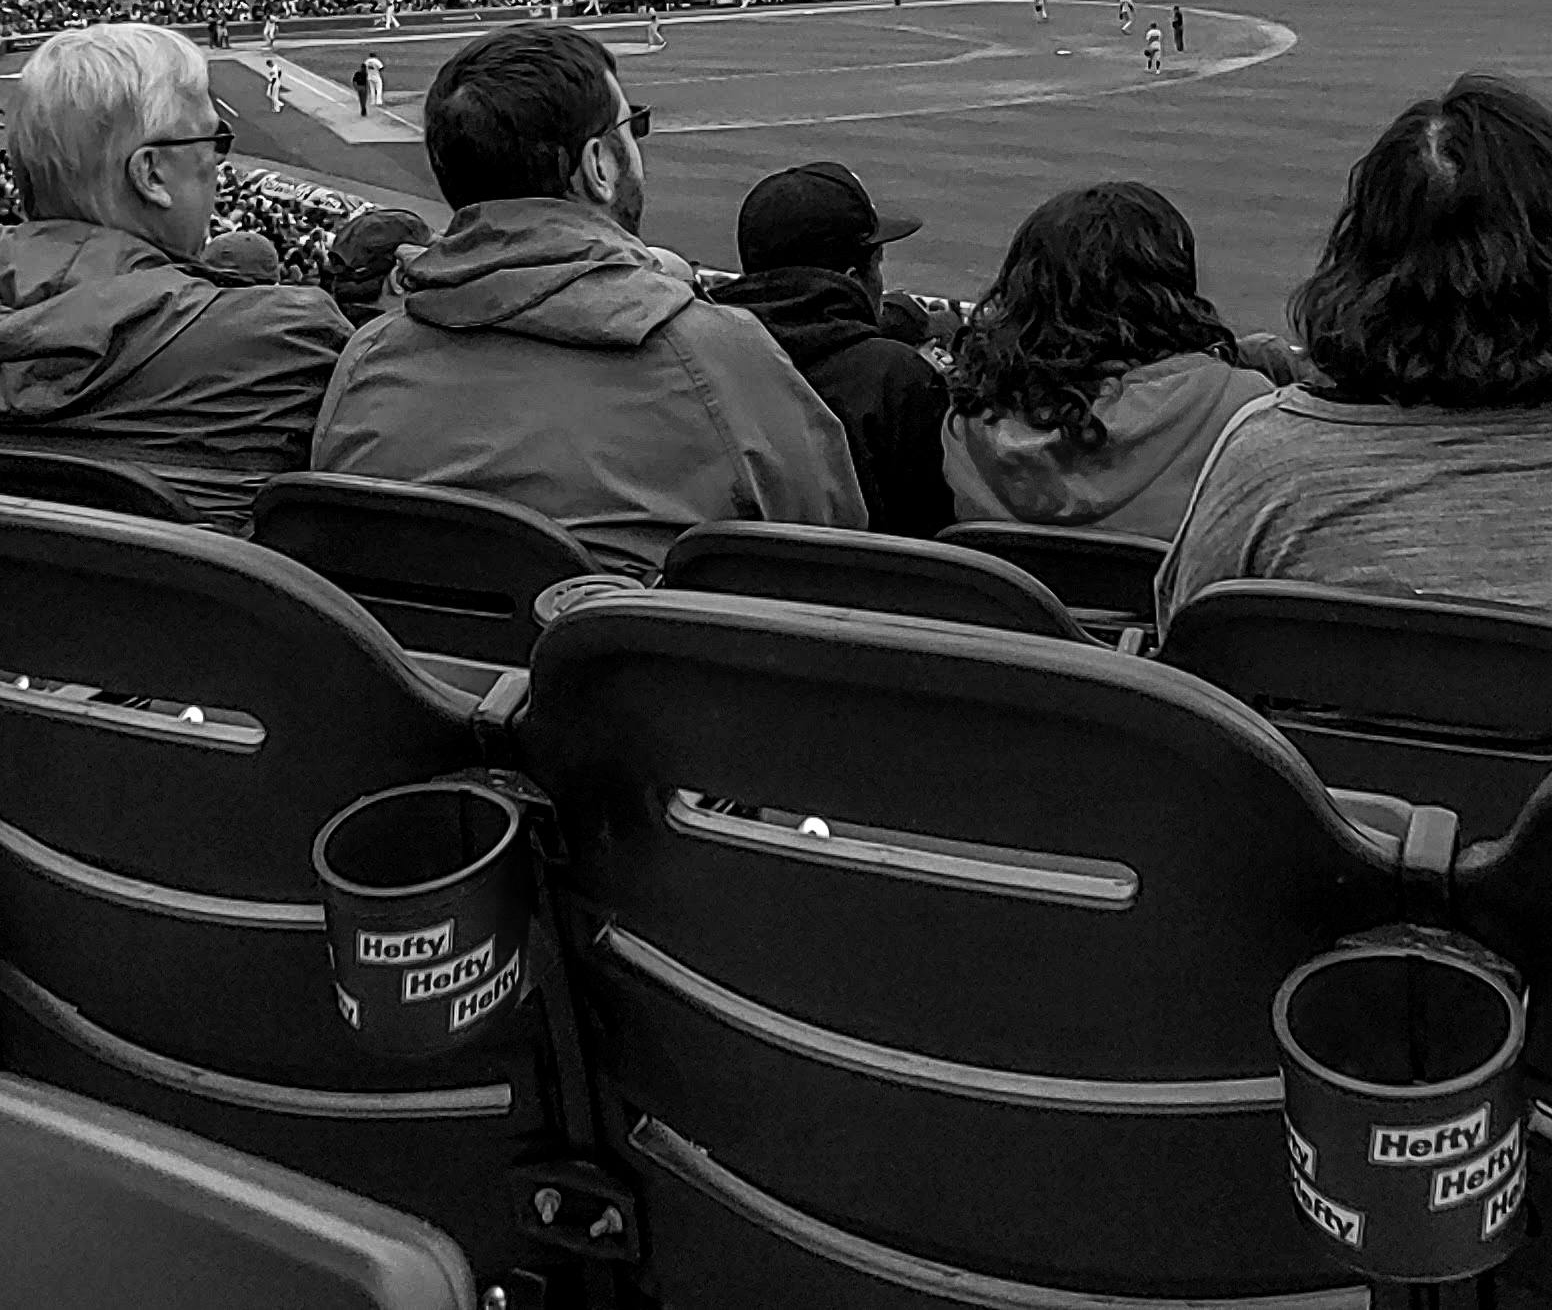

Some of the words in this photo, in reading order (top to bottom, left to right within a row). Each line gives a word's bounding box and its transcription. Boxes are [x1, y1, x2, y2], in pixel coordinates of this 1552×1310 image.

[363, 935, 446, 959] Hefty
[409, 951, 490, 995] Hefty
[457, 962, 518, 1021] Hefty
[1379, 1120, 1482, 1158] Hefty
